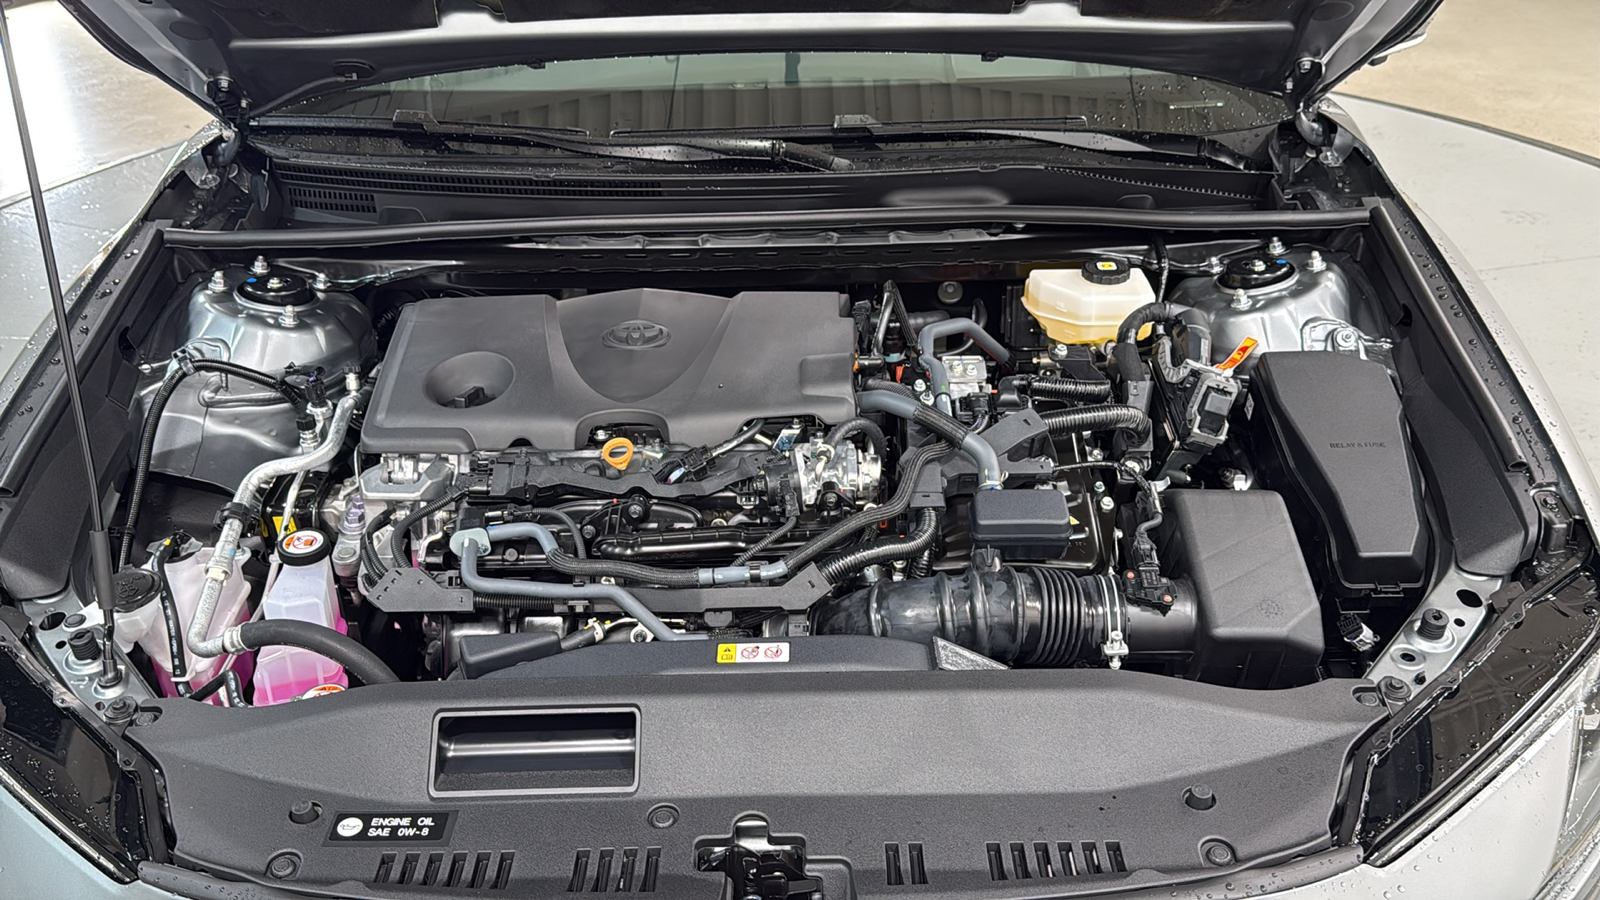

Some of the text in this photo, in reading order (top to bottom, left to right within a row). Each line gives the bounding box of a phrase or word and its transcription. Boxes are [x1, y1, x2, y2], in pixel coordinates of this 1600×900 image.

[371, 817, 435, 826] ENGINE OIL
[367, 827, 430, 837] SAE 0W-8
